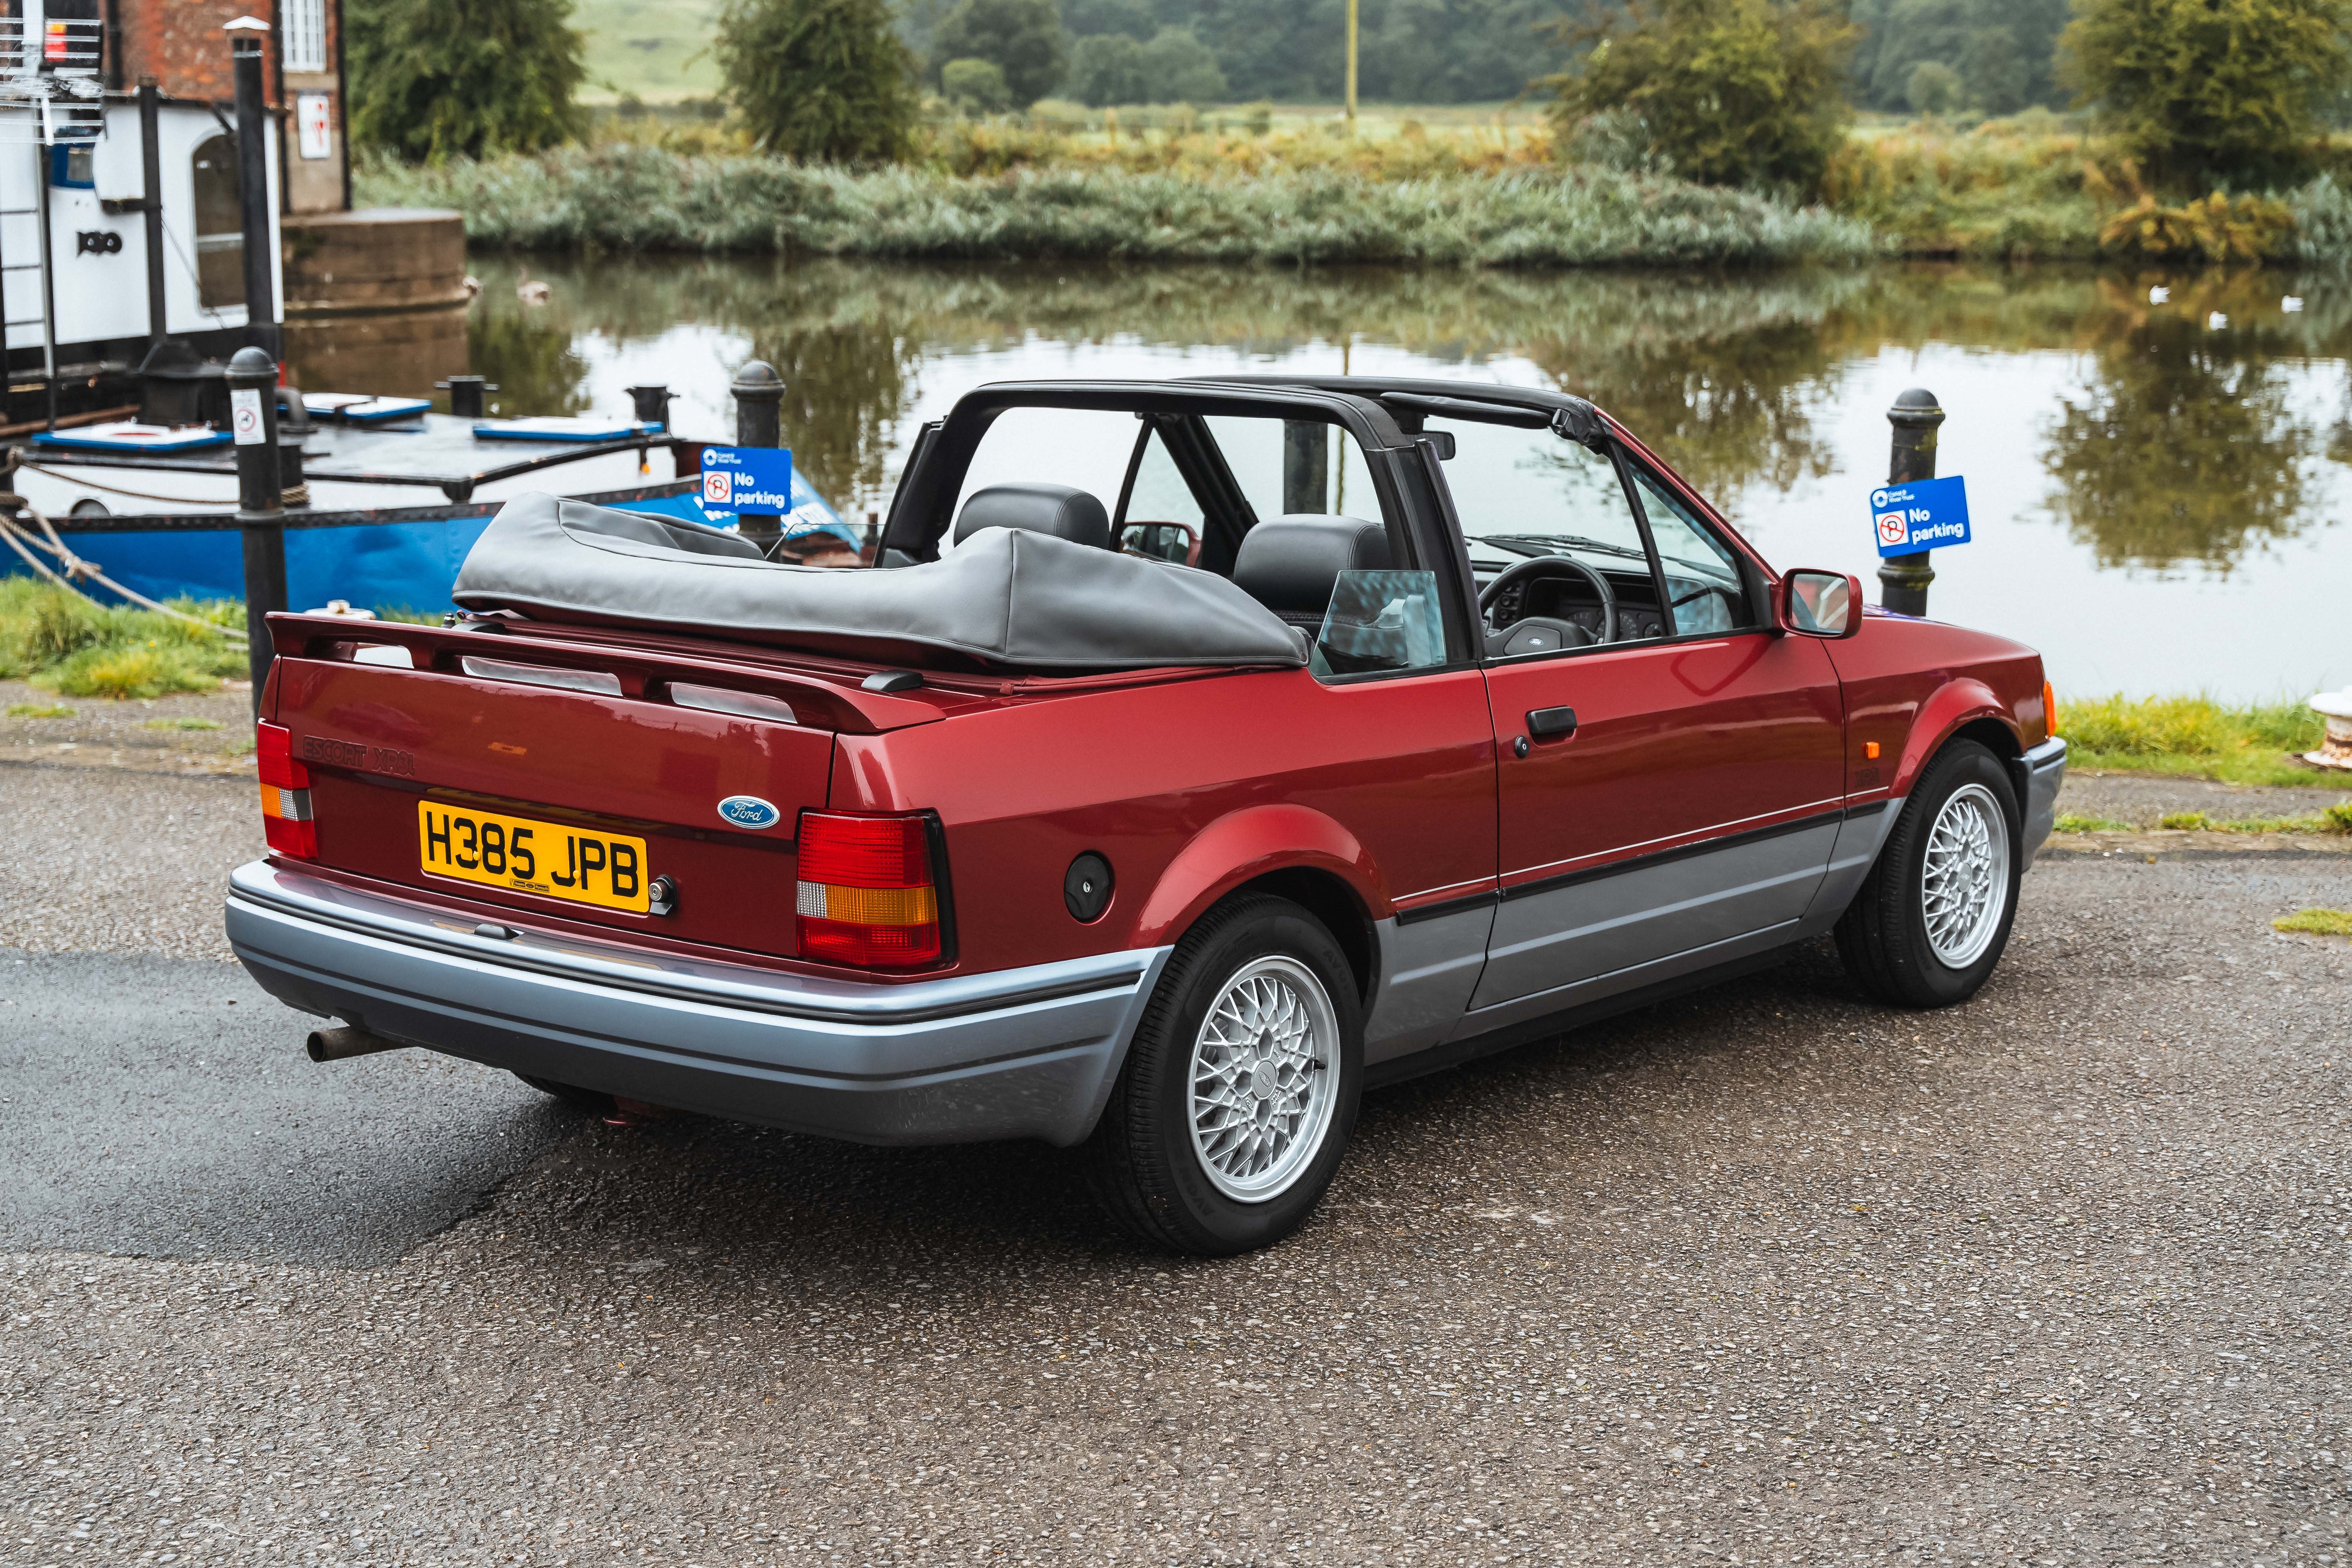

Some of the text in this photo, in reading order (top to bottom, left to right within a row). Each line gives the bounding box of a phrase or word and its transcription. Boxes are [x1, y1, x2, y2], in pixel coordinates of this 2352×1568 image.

[734, 471, 754, 486] No
[734, 490, 785, 509] parking
[1909, 507, 1930, 523] No
[1912, 522, 1964, 545] parking
[303, 735, 368, 768] ESCORT
[731, 801, 763, 821] Ford
[426, 810, 639, 898] H385 JPB
